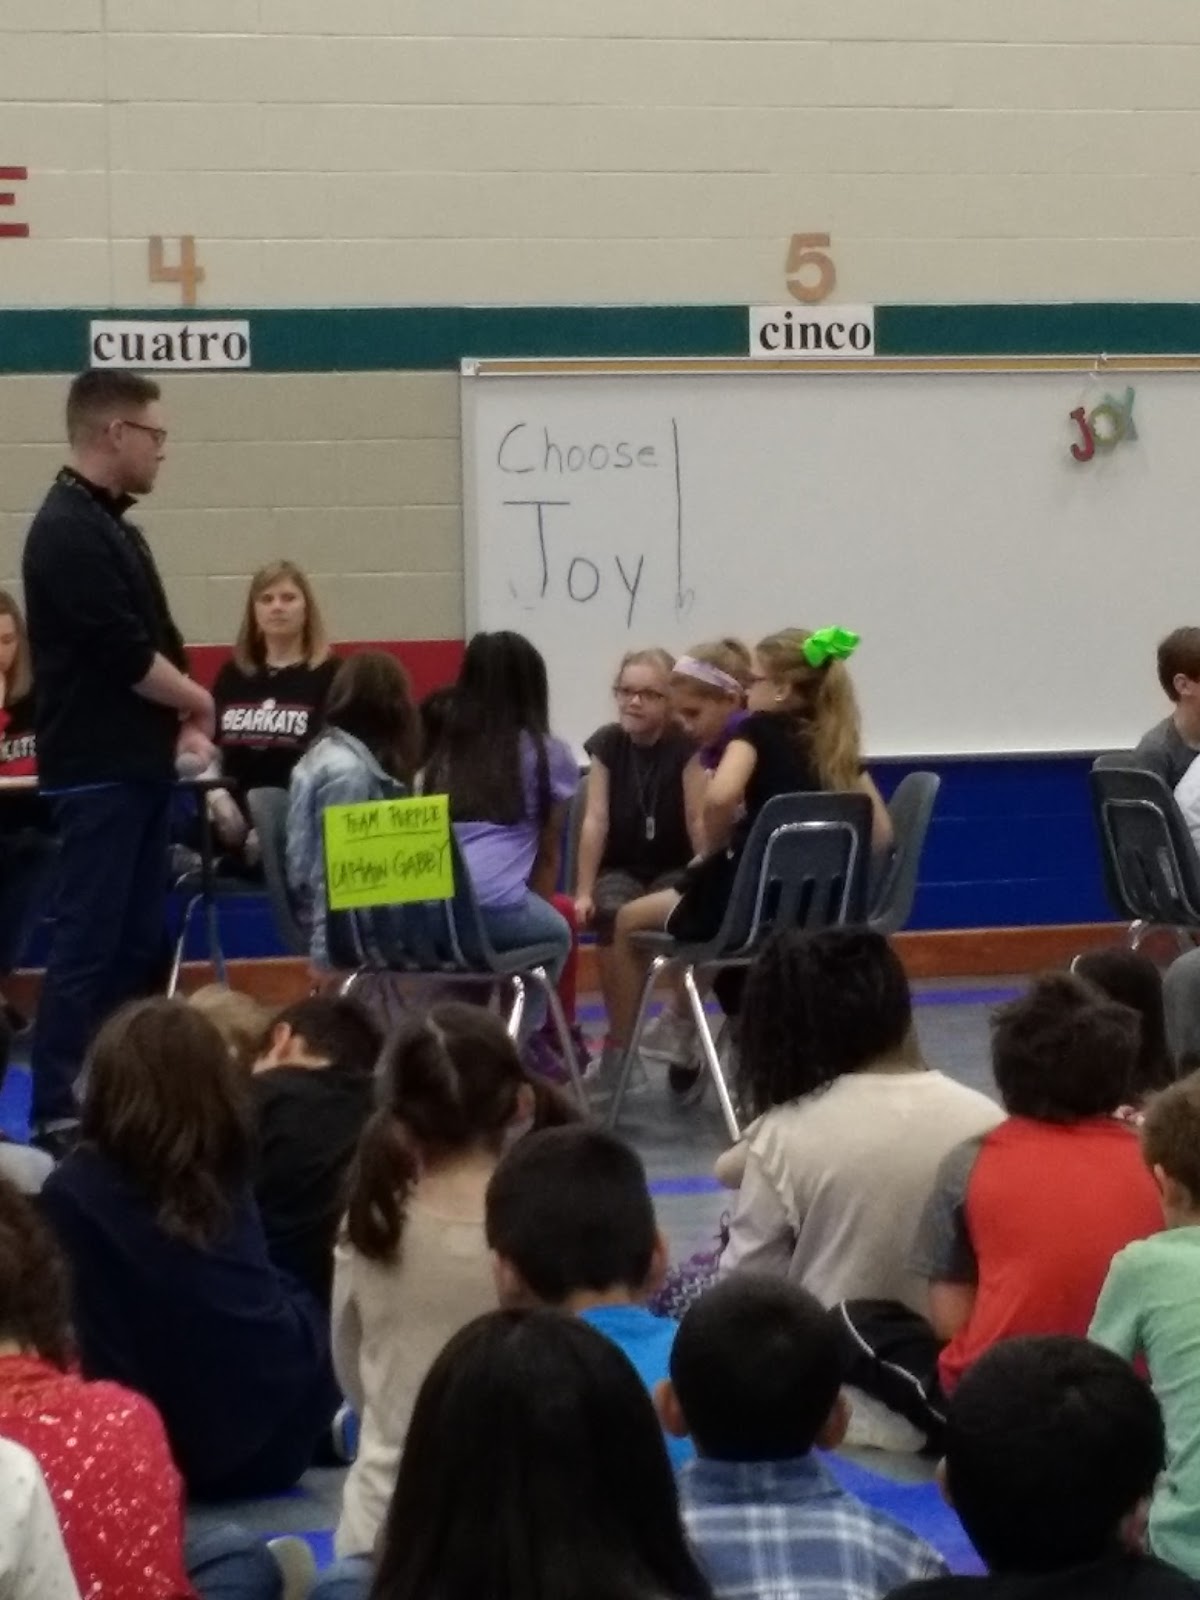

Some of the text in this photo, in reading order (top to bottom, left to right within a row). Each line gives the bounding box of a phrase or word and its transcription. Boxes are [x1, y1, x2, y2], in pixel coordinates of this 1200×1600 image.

[148, 235, 206, 307] 4
[785, 232, 837, 303] 5
[92, 324, 248, 362] cuatro
[759, 311, 872, 351] cinco
[498, 422, 658, 474] Choose
[222, 708, 309, 736] BEARKATS
